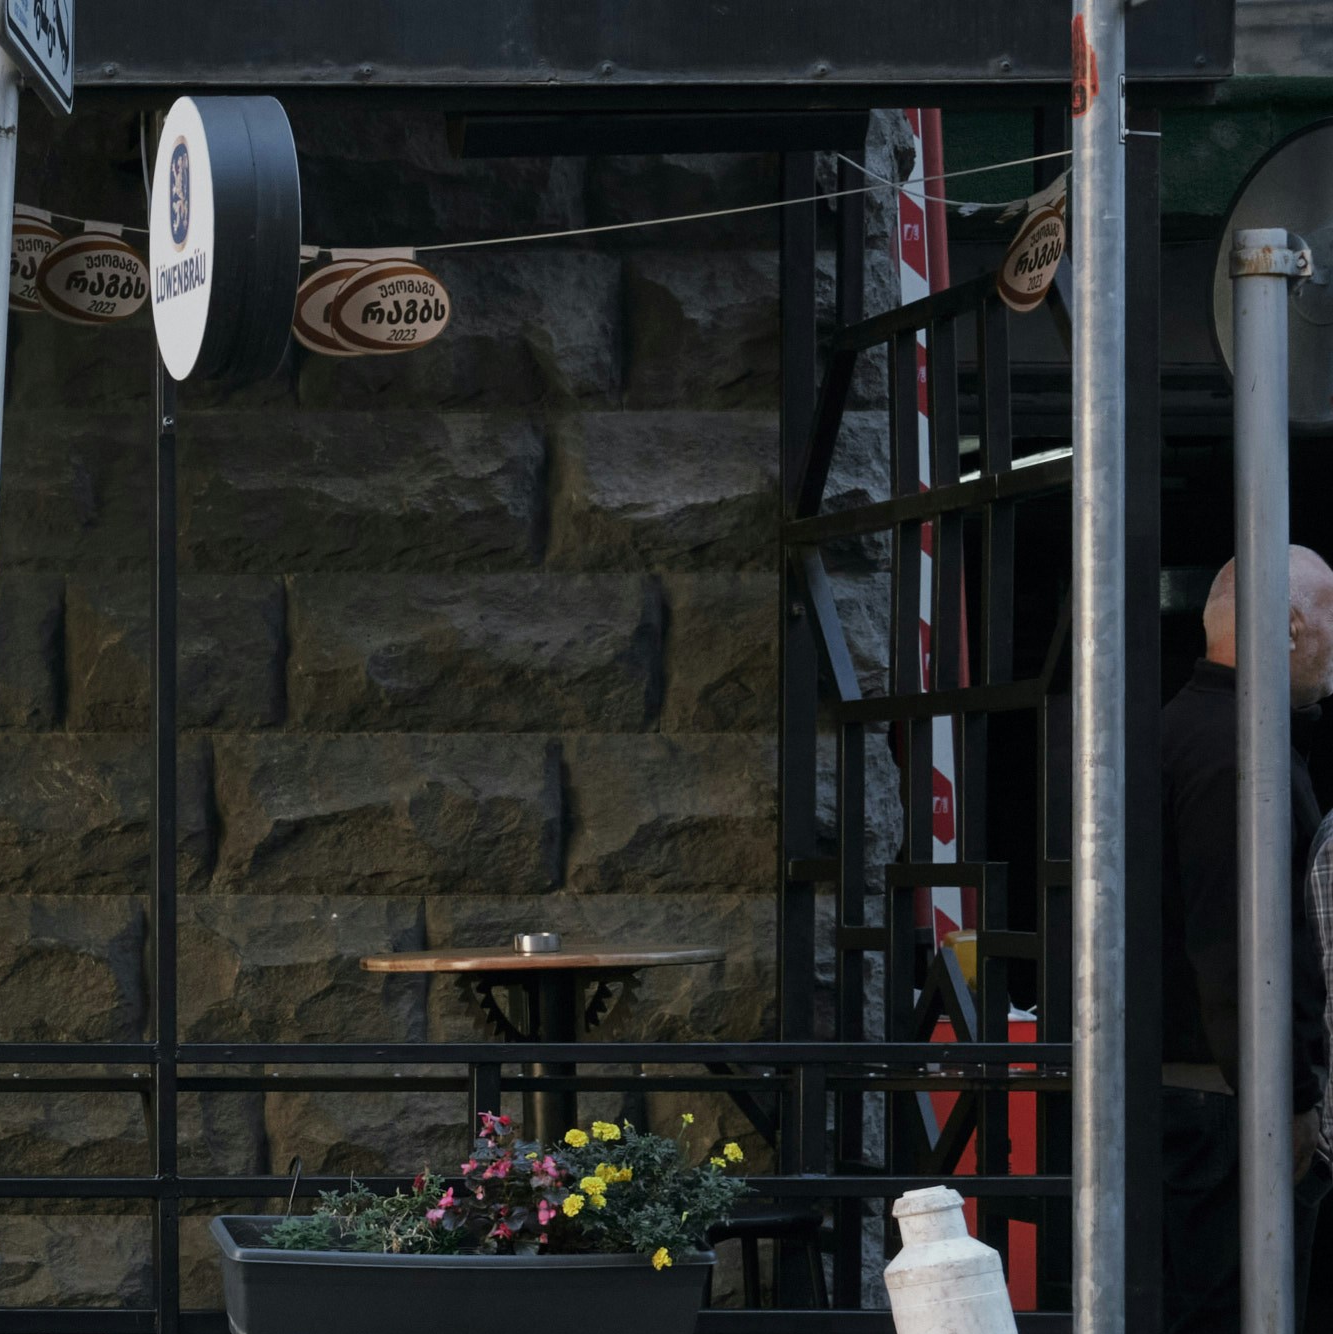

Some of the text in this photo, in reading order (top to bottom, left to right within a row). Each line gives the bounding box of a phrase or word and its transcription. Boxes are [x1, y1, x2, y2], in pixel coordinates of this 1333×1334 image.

[85, 254, 139, 275] უქომაგე
[65, 270, 146, 299] რაგბს
[155, 249, 206, 305] LÖWENBRÄU
[378, 280, 436, 298] უქომაგე
[87, 300, 117, 314] 2023
[361, 298, 446, 325] რაგბს
[386, 329, 417, 341] 2023
